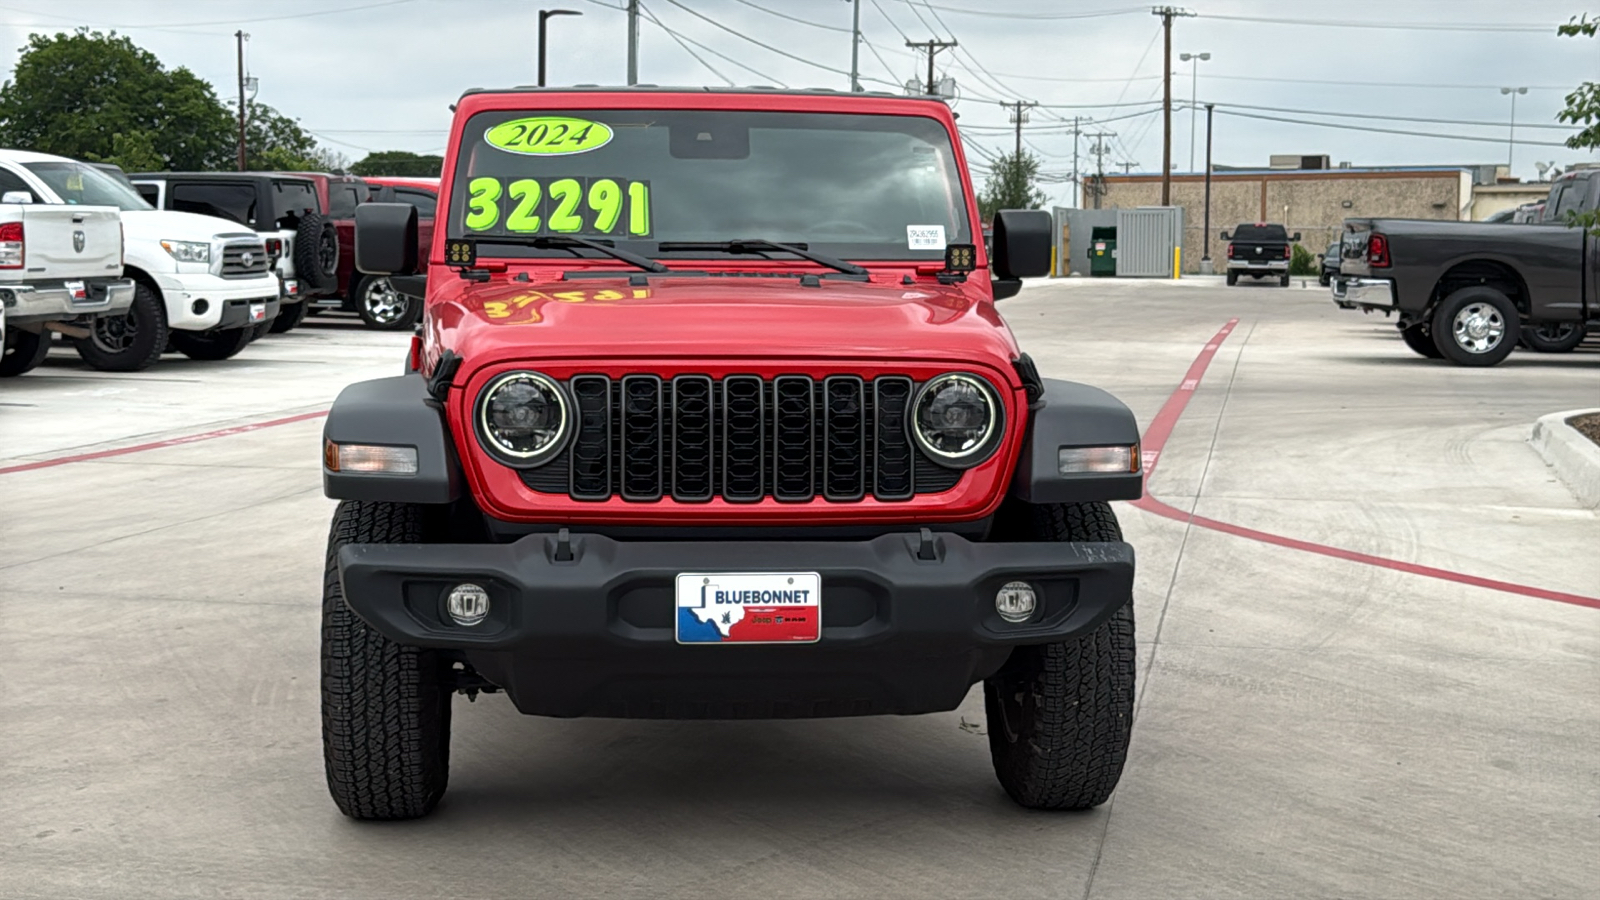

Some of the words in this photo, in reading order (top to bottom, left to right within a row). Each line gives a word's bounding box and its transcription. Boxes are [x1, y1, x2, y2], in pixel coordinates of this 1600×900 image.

[504, 124, 594, 146] 2024
[465, 177, 650, 236] 32291
[715, 590, 810, 604] BLUEBONNET
